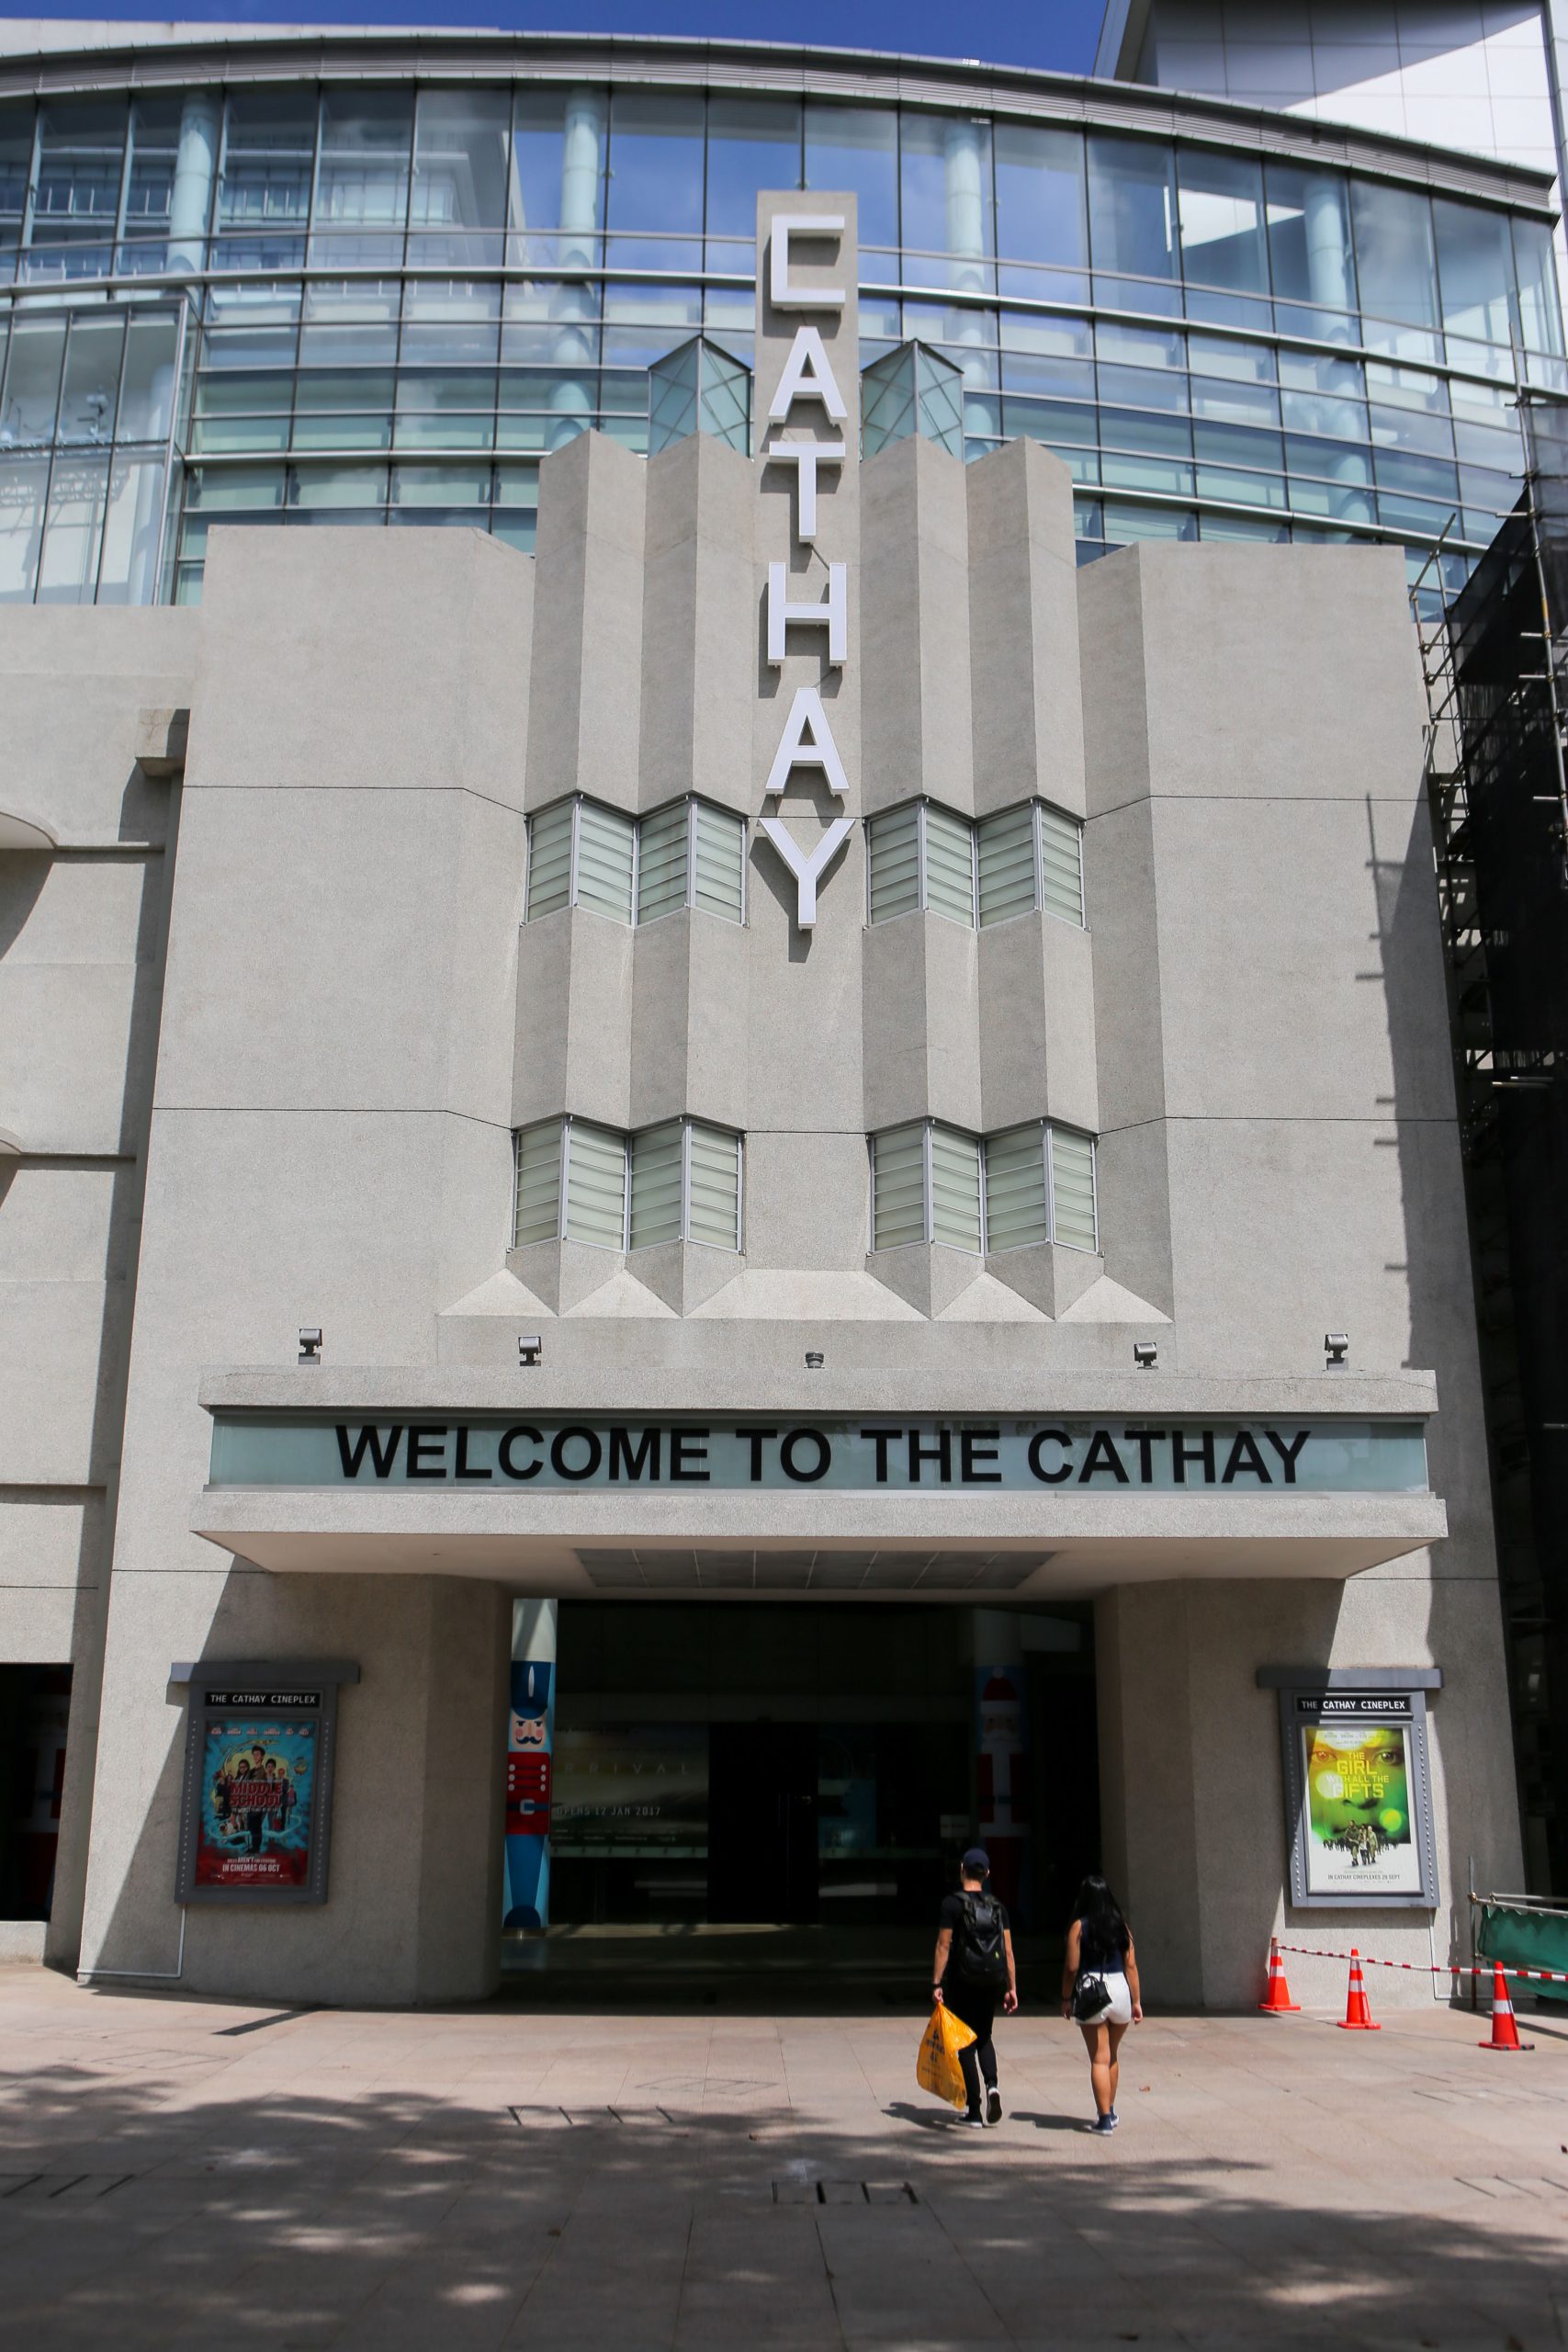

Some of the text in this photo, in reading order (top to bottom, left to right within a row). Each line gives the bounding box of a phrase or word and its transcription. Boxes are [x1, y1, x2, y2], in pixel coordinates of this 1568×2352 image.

[759, 213, 858, 931] CATHAY
[334, 1424, 1312, 1485] WELCOME TO THE CATHAY
[210, 1694, 316, 1704] THE CATHAY CINEPLEX
[1301, 1701, 1405, 1710] THE CATHAY CINEPLEX
[1348, 1752, 1366, 1760] THE
[1337, 1759, 1378, 1775] GIRL
[1352, 1775, 1370, 1783] ALL
[1372, 1775, 1390, 1783] THE
[231, 1781, 283, 1795] MIDDLE
[1333, 1782, 1384, 1799] GIFTS
[230, 1794, 283, 1808] SCHOOL
[595, 1806, 606, 1816] 12
[611, 1806, 630, 1816] JAN
[636, 1806, 660, 1816] 2017
[222, 1863, 230, 1872] IN
[230, 1863, 258, 1872] CINEMAS
[267, 1863, 280, 1873] OCT
